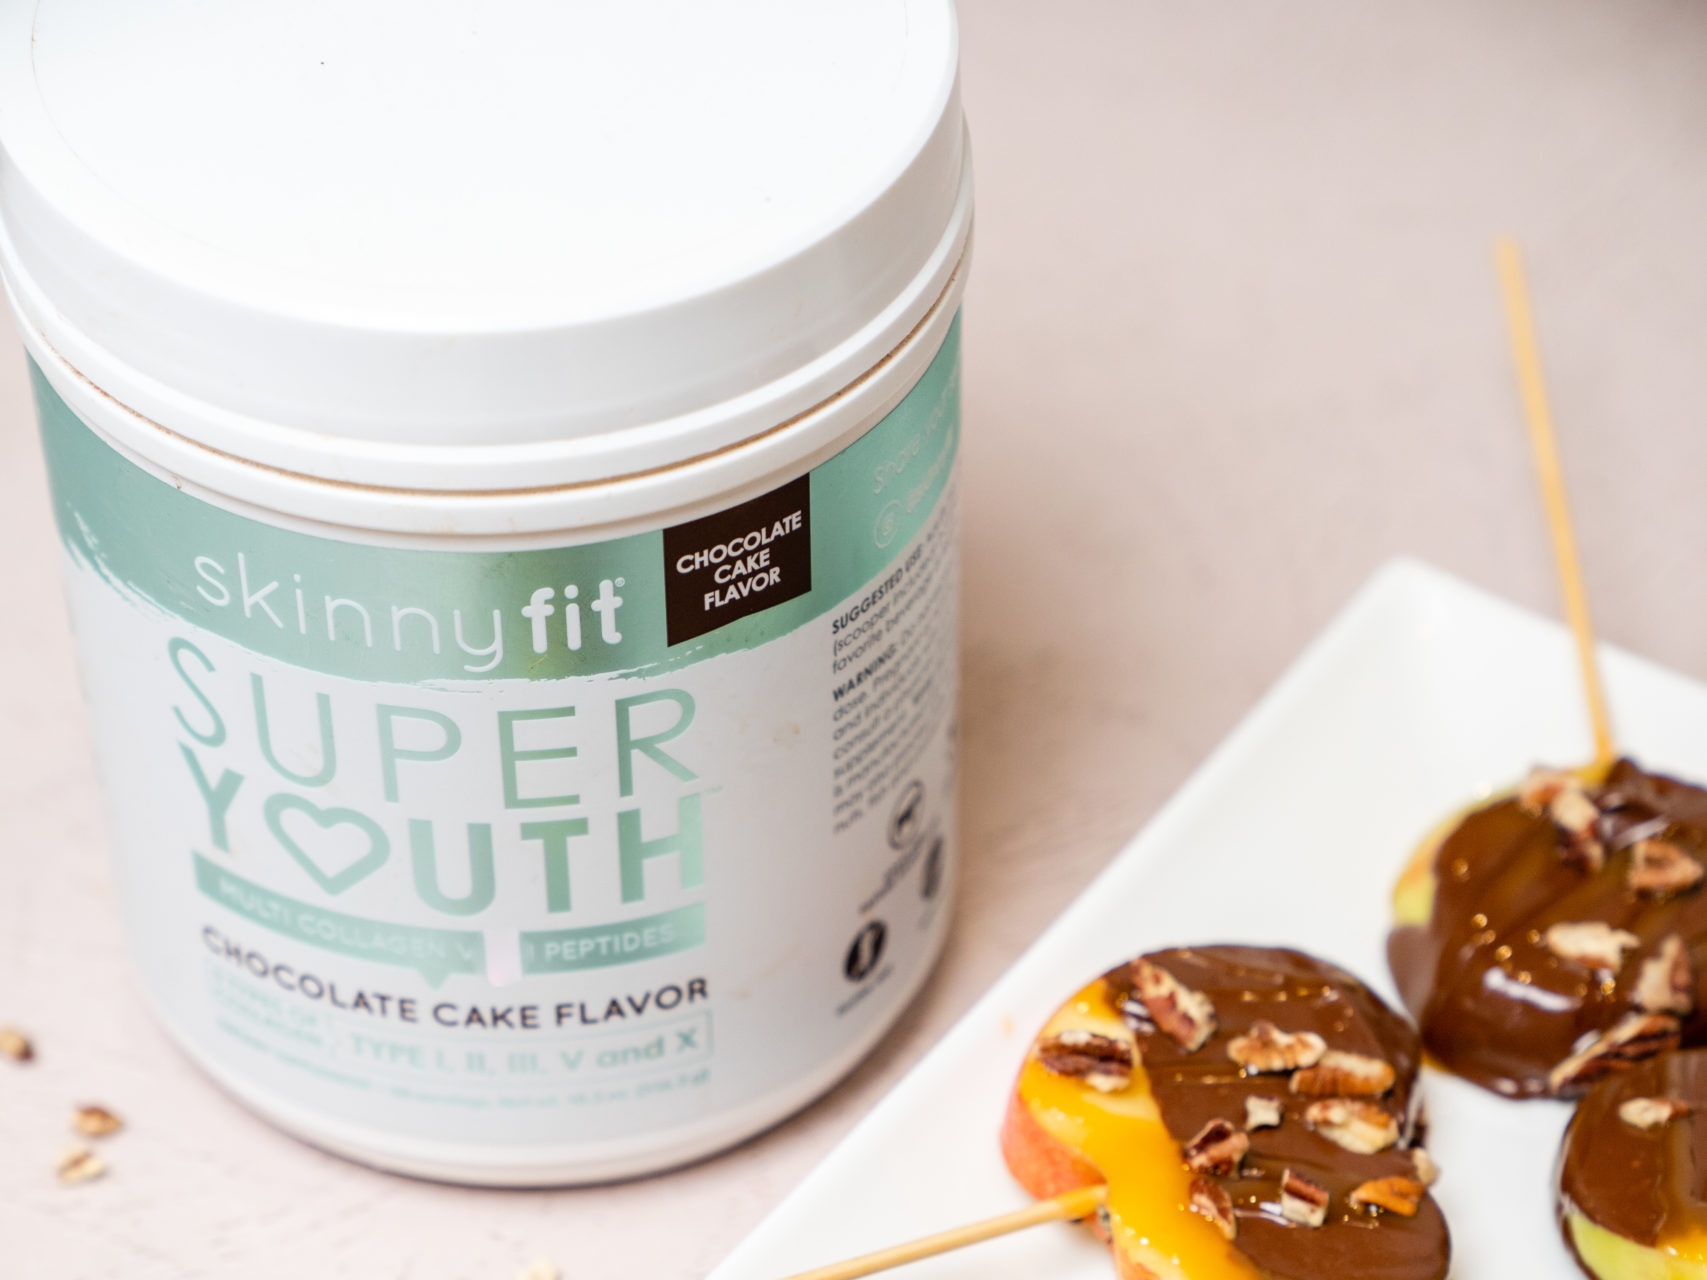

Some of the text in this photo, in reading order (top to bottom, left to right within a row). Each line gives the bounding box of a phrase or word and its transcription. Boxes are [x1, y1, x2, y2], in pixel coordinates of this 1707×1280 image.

[676, 510, 802, 574] CHOCOLATE
[714, 548, 770, 584] CAKE
[704, 566, 781, 611] FLAVOR
[832, 568, 904, 635] SUGGESTED
[167, 636, 699, 810] SUPER
[218, 876, 291, 925] MULTI
[296, 913, 448, 960] COLLAGEN
[544, 922, 677, 962] PEPTIDES
[201, 924, 420, 1024] CHOCOLATE
[431, 1001, 541, 1030] CAKE
[554, 976, 710, 1029] FLAVOR
[351, 1033, 425, 1069] TYPE
[560, 1049, 585, 1072] V
[596, 1034, 666, 1069] and
[674, 1026, 699, 1053] X
